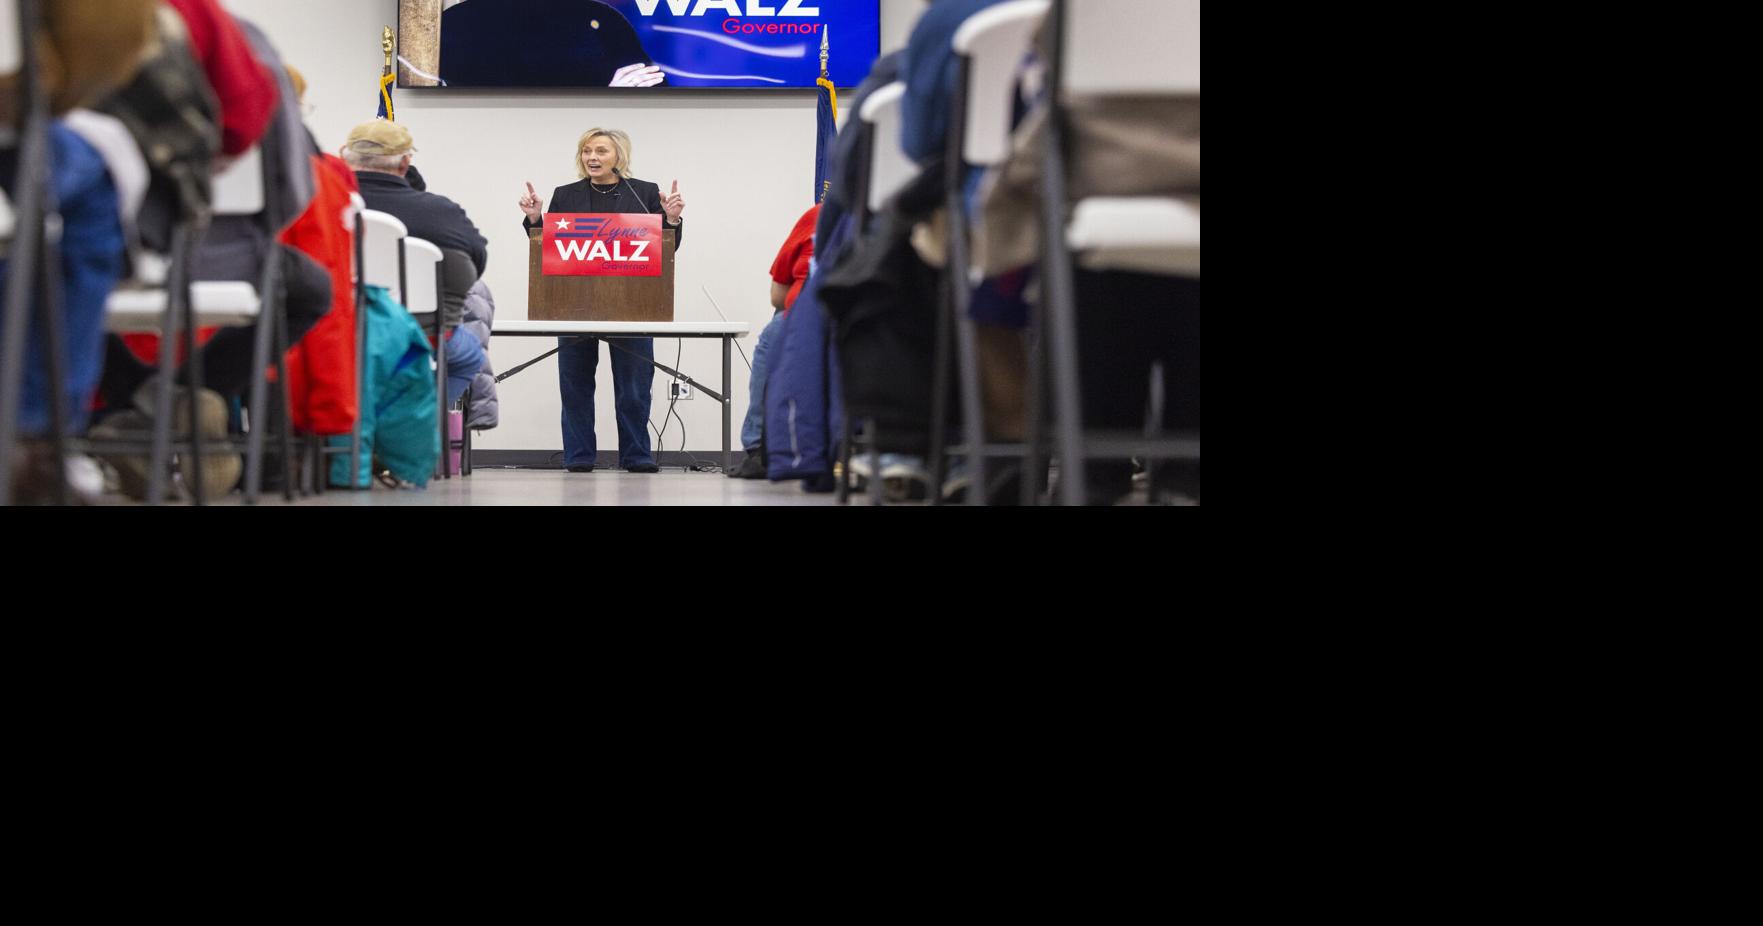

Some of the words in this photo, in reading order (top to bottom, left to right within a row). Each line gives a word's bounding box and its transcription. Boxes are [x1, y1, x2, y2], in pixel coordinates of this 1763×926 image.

[722, 18, 820, 34] Governor
[597, 218, 648, 244] Lynne
[554, 240, 650, 261] WALZ
[601, 261, 649, 270] Governor
